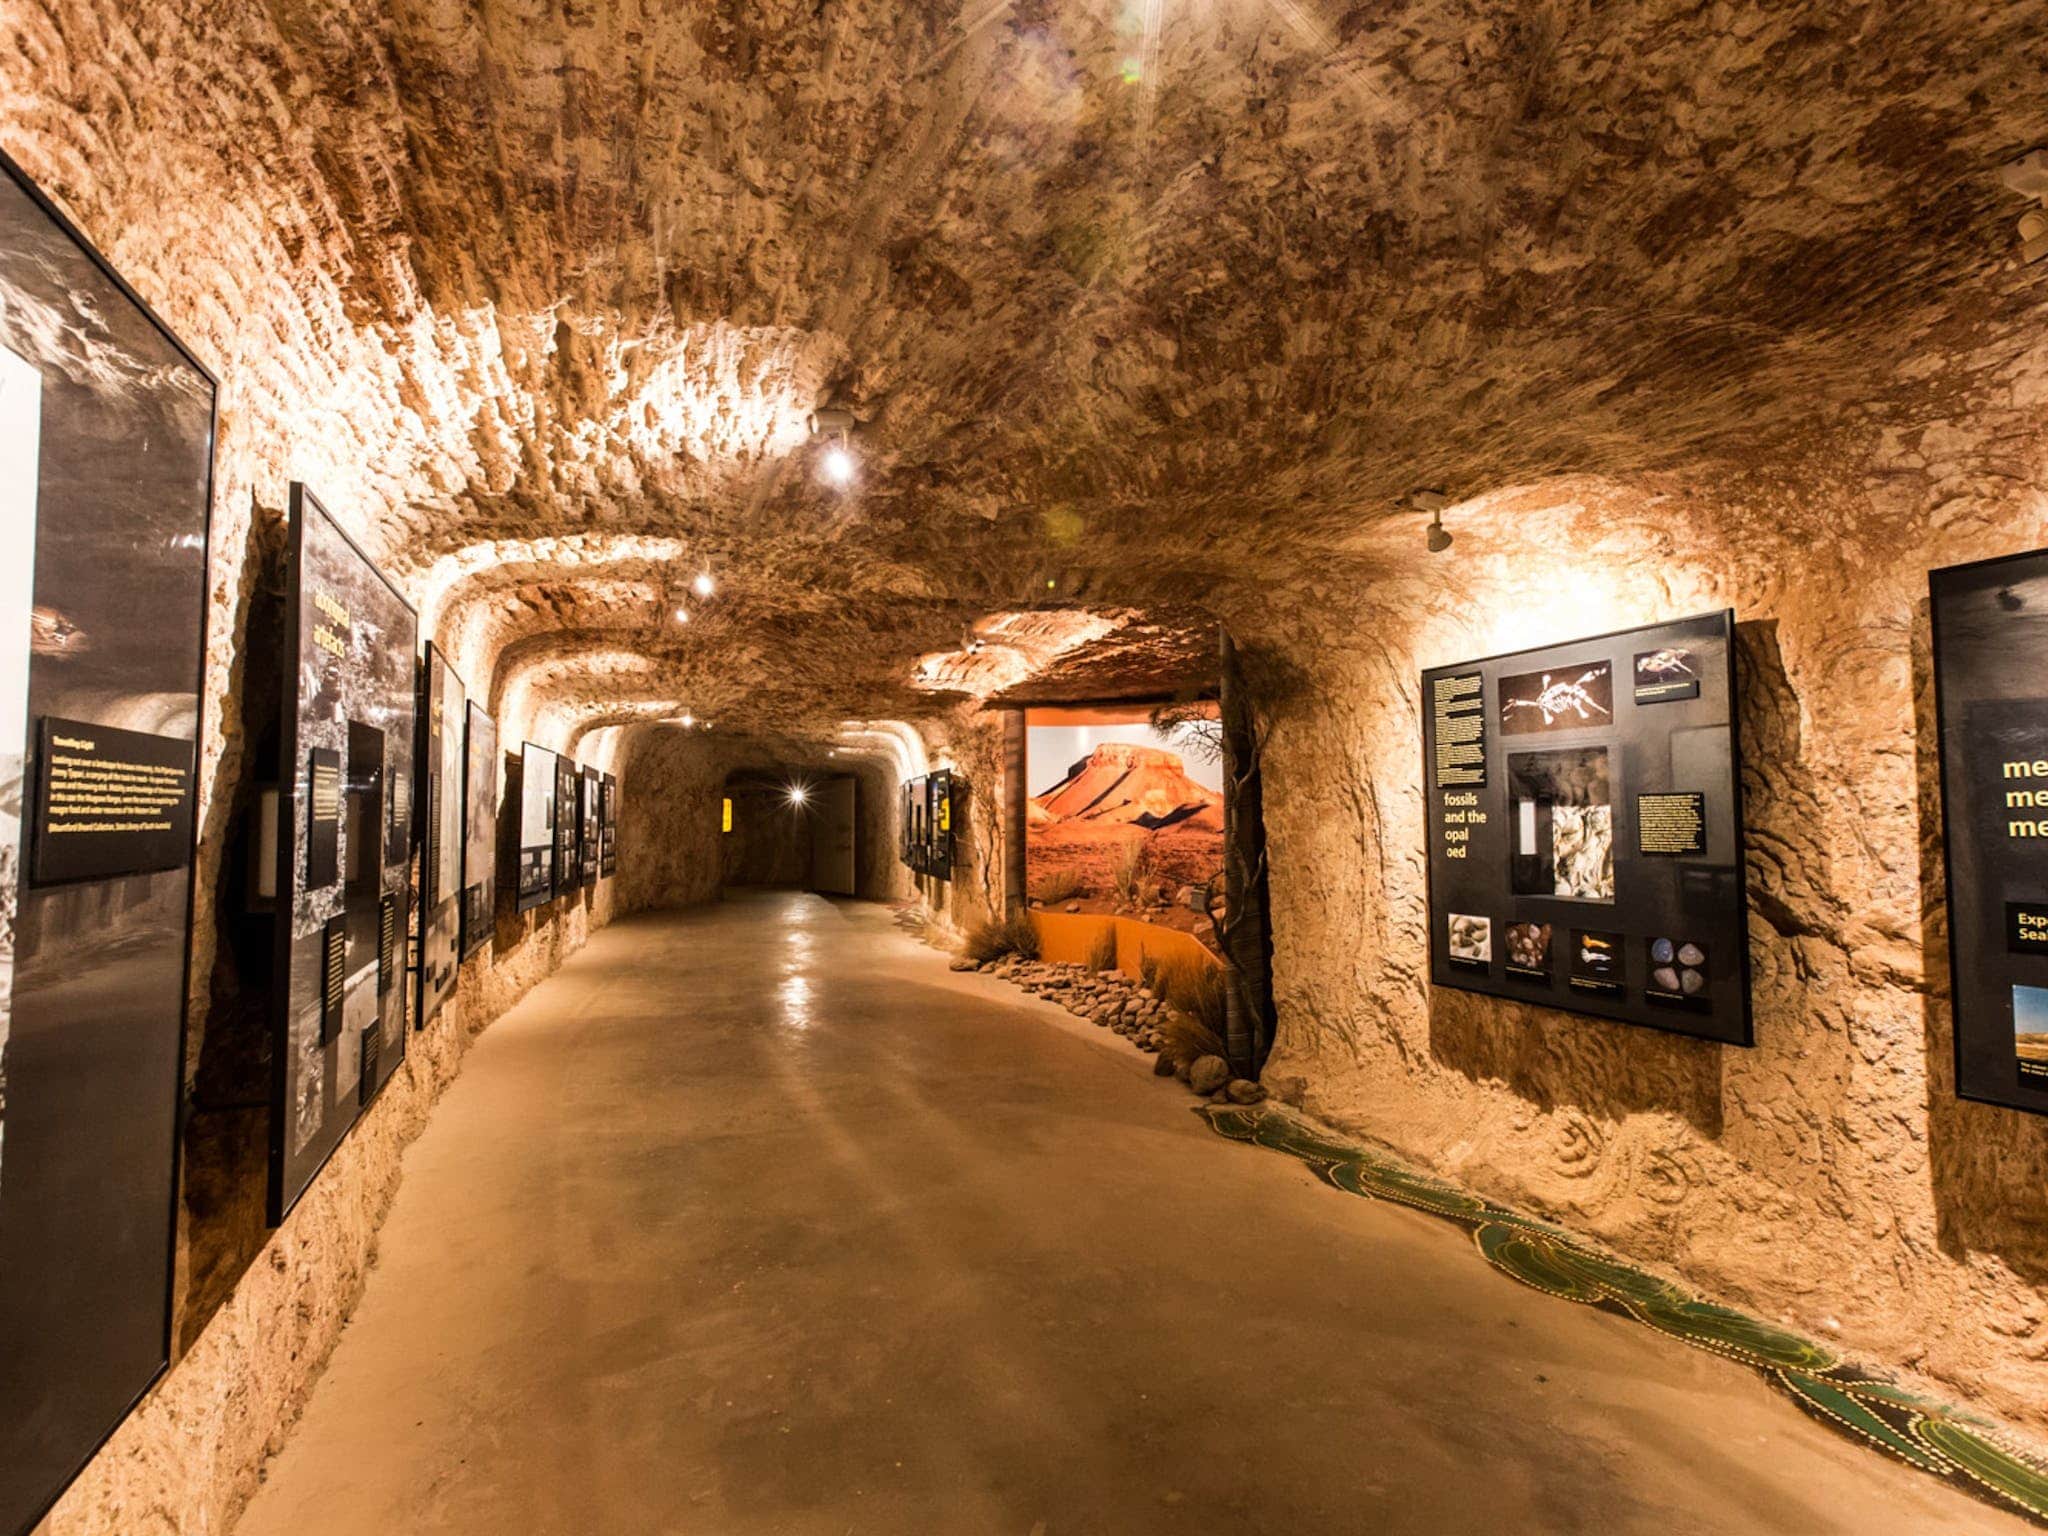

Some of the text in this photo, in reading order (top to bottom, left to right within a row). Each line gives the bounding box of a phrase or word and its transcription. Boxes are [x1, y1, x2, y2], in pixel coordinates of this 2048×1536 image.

[314, 585, 350, 629] aboriginal
[313, 624, 345, 658] artefacts
[1444, 792, 1478, 806] fossils
[1445, 810, 1487, 823] and the
[1445, 827, 1469, 843] opal
[2018, 912, 2048, 928] Exp
[2019, 927, 2048, 941] Sea
